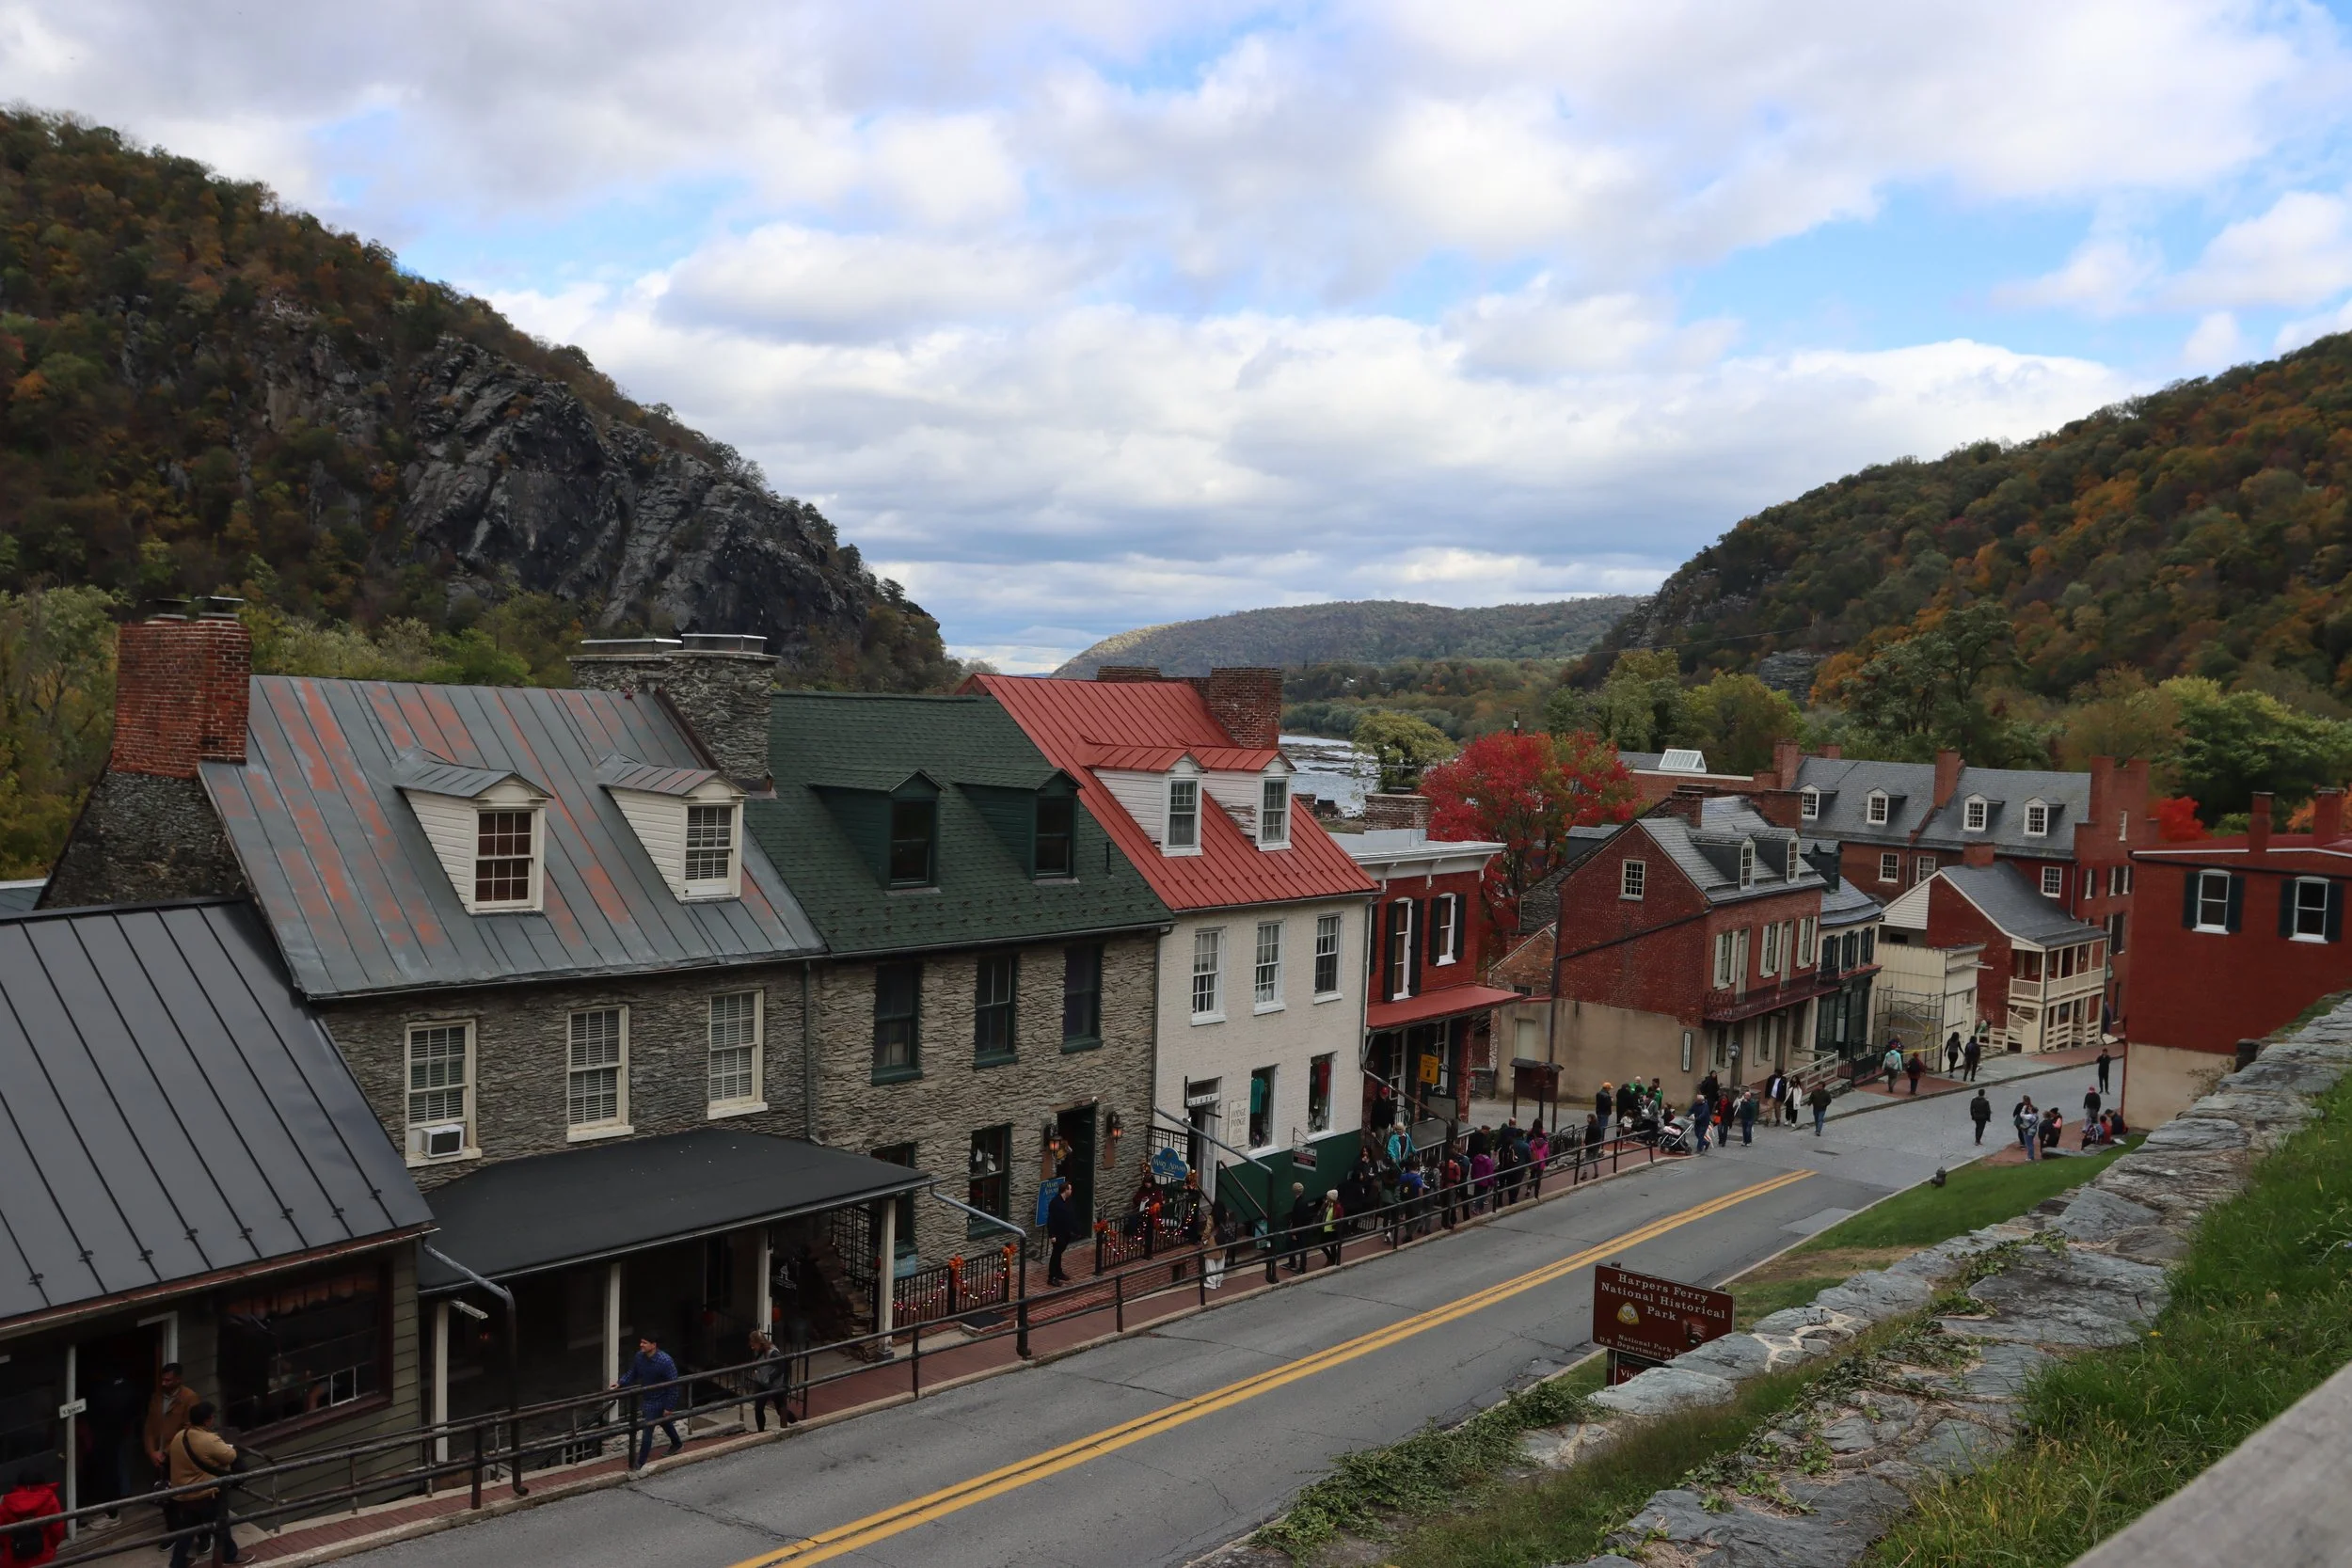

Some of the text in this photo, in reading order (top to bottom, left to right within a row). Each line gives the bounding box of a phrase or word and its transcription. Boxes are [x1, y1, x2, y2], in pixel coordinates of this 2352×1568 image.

[1618, 1273, 1708, 1304] Harpers Ferry
[1601, 1281, 1725, 1319] National Historical
[1646, 1306, 1677, 1321] Park
[1599, 1337, 1613, 1345] U.S.
[1617, 1340, 1661, 1357] Department
[1618, 1334, 1651, 1347] National
[1654, 1343, 1672, 1353] Park
